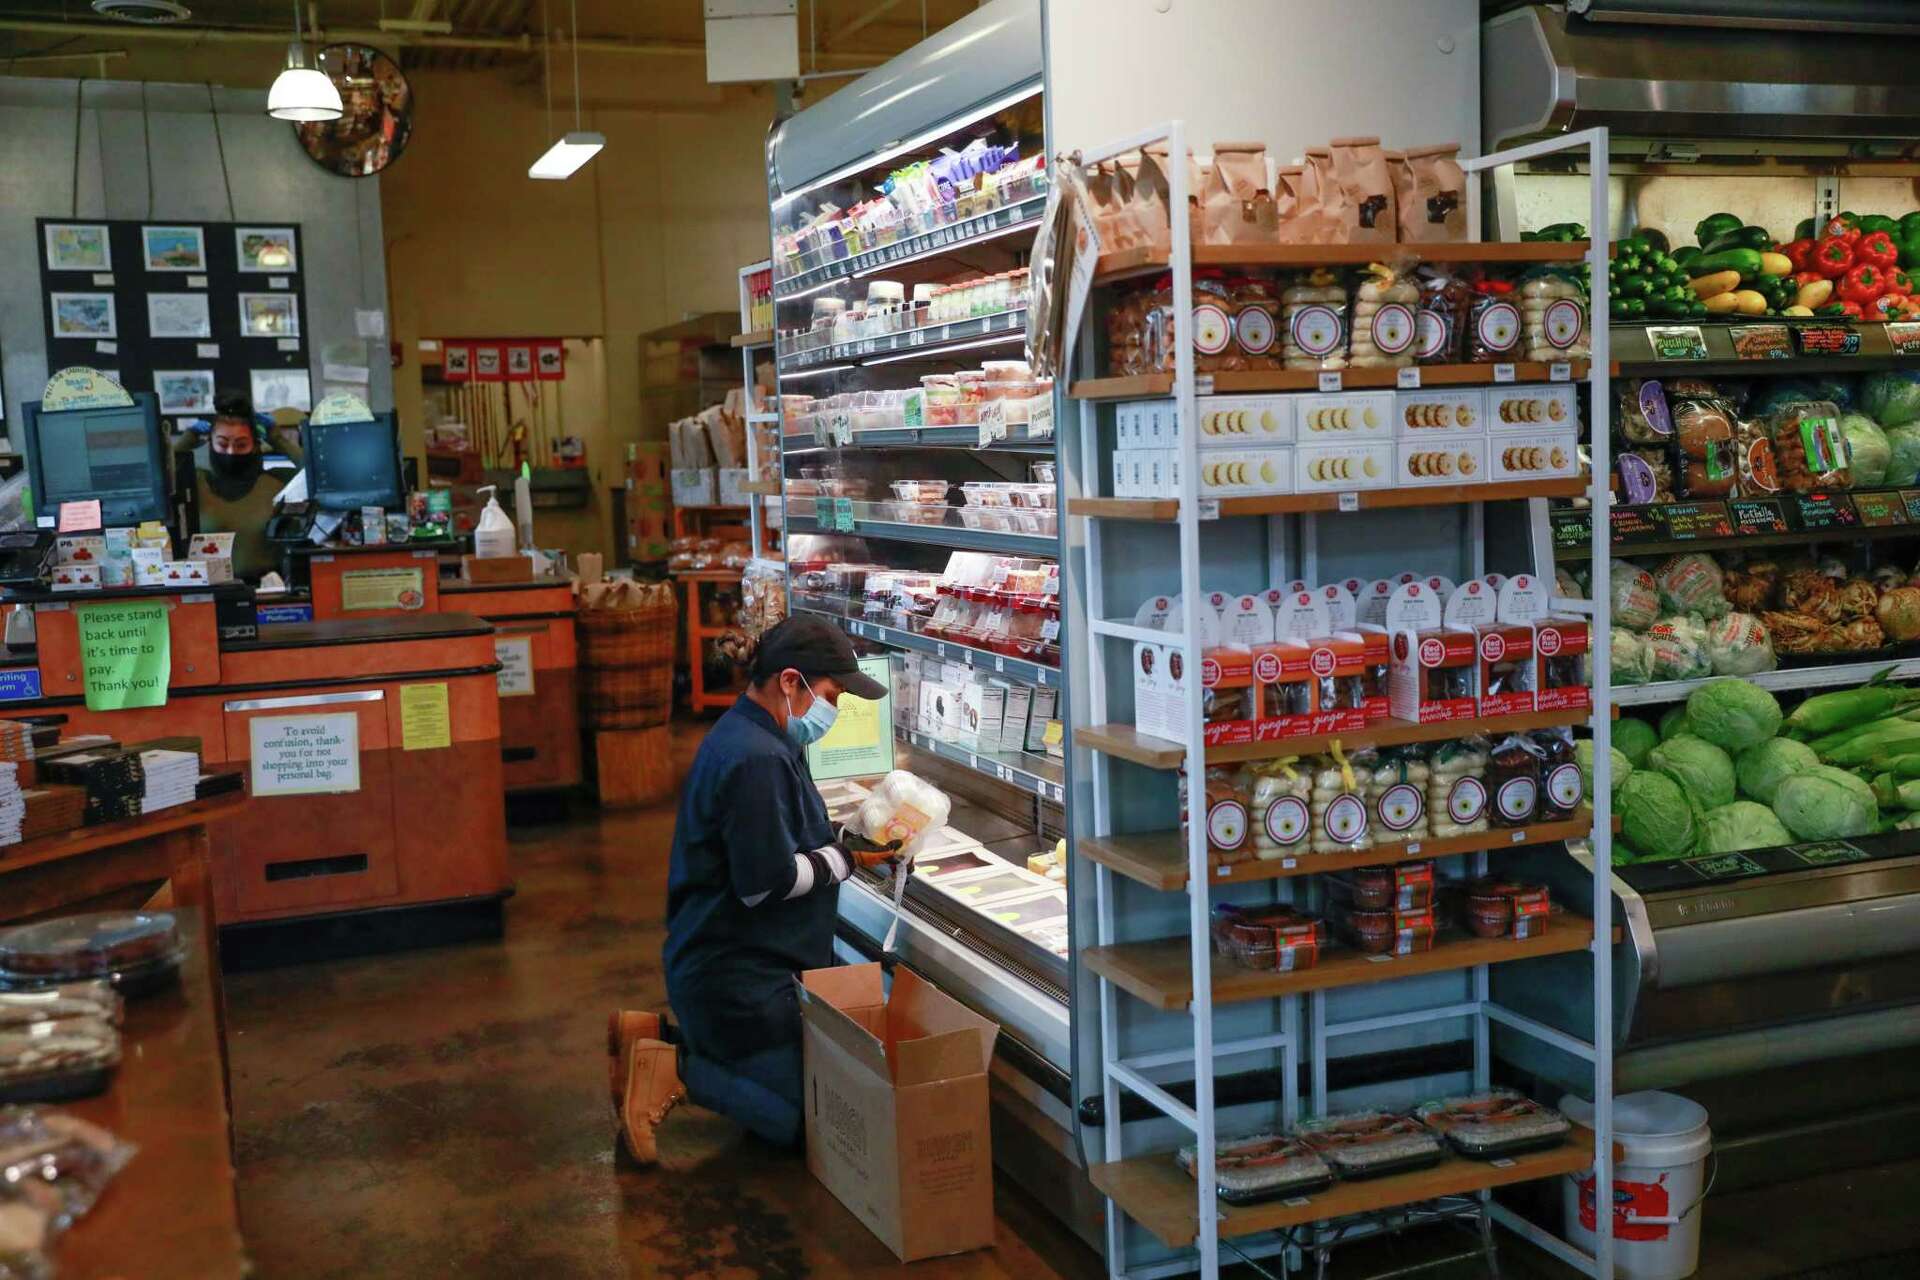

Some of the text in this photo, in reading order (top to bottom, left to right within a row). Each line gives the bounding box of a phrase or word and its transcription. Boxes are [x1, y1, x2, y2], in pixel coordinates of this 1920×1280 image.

[83, 608, 162, 623] Please stand
[85, 626, 146, 641] back until
[87, 644, 155, 658] it's time to
[89, 665, 115, 678] pay.
[90, 676, 160, 693] Thank you!
[1311, 711, 1346, 734] ginger
[283, 725, 326, 737] To avoid
[1258, 718, 1291, 742] ginger
[279, 748, 332, 761] you for not
[262, 758, 348, 772] shopping into your
[277, 769, 314, 783] personal
